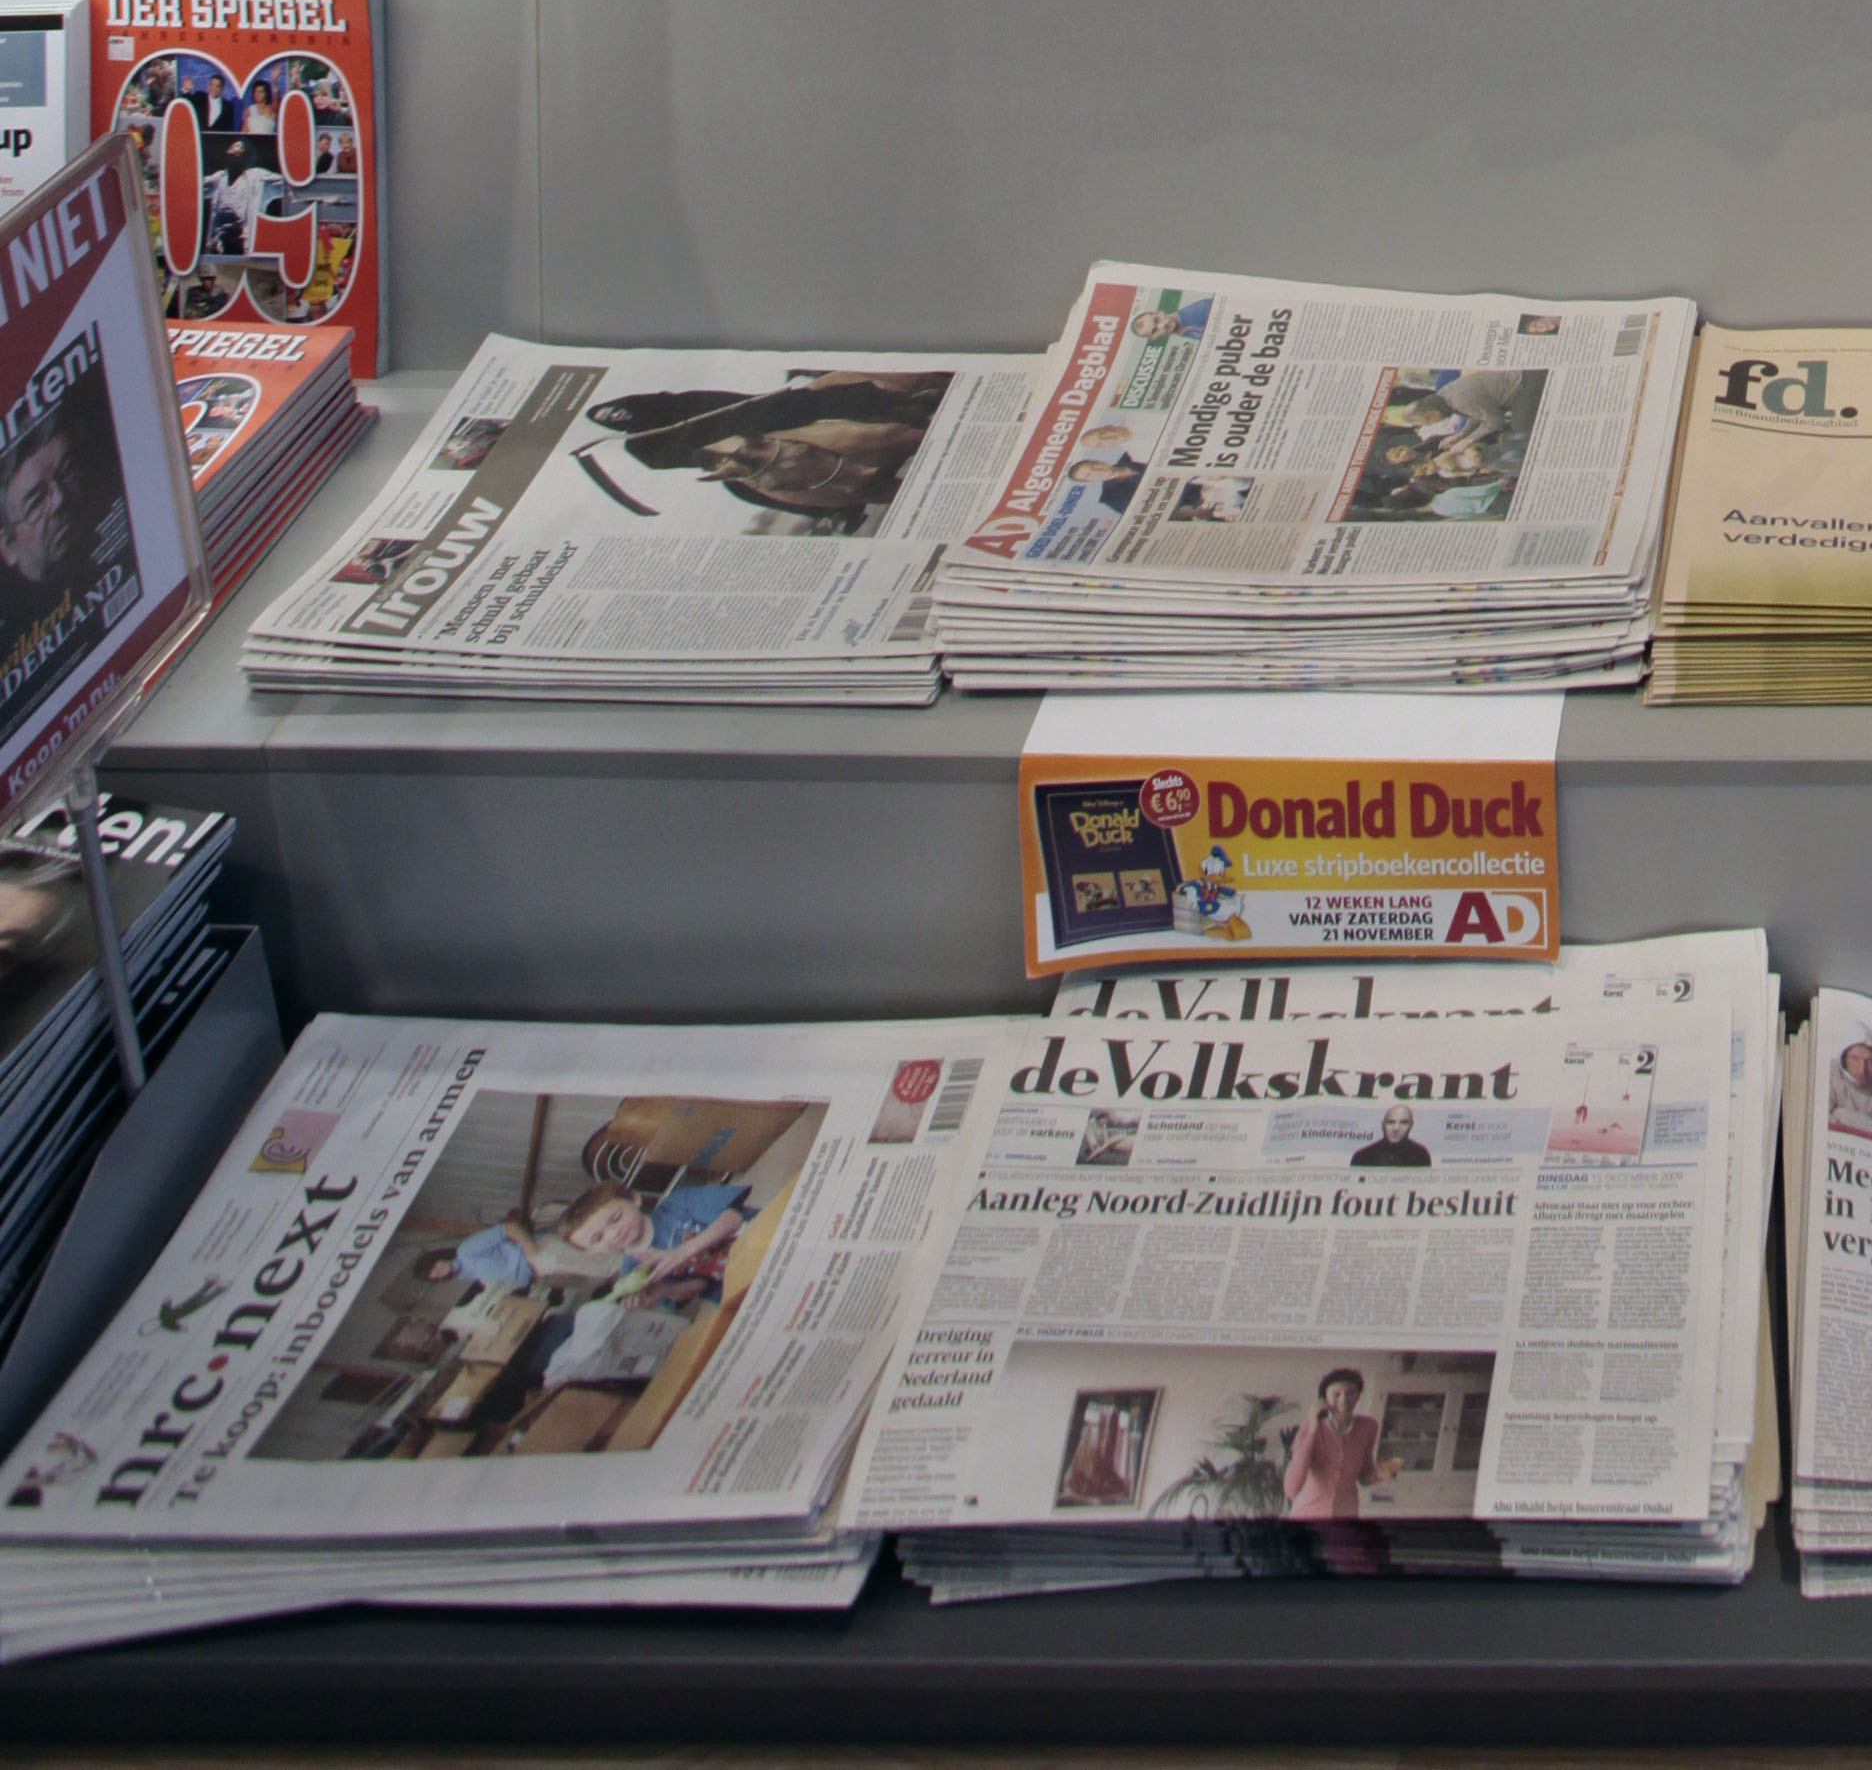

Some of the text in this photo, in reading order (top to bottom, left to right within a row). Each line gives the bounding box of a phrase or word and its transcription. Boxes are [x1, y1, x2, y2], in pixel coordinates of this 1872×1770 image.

[1170, 314, 1254, 468] Mondige puber
[1206, 309, 1293, 469] is ouder de baas
[965, 315, 1121, 560] AD Algemeen Dagblad
[353, 497, 504, 631] Trouw
[489, 554, 520, 582] met
[466, 550, 551, 644] schuld gebaar
[487, 617, 519, 645] bij
[1069, 810, 1139, 829] Donald
[1208, 781, 1543, 839] Donald Duck
[1082, 827, 1134, 847] Duck
[1242, 852, 1546, 881] Luxe stripboekencollectie
[1305, 895, 1432, 909] 12 WEKEN LANG
[1290, 911, 1433, 925] VANAF ZATERDAG
[1444, 890, 1546, 947] AD
[1323, 927, 1434, 941] 21 NOVEMBER
[968, 1187, 1519, 1220] Aanleg Noord-Zuidlijn fout besluit
[1824, 1190, 1854, 1219] in
[170, 1461, 215, 1510] Te
[275, 1204, 390, 1366] inboedels
[382, 1147, 427, 1202] van
[422, 1047, 487, 1142] armen
